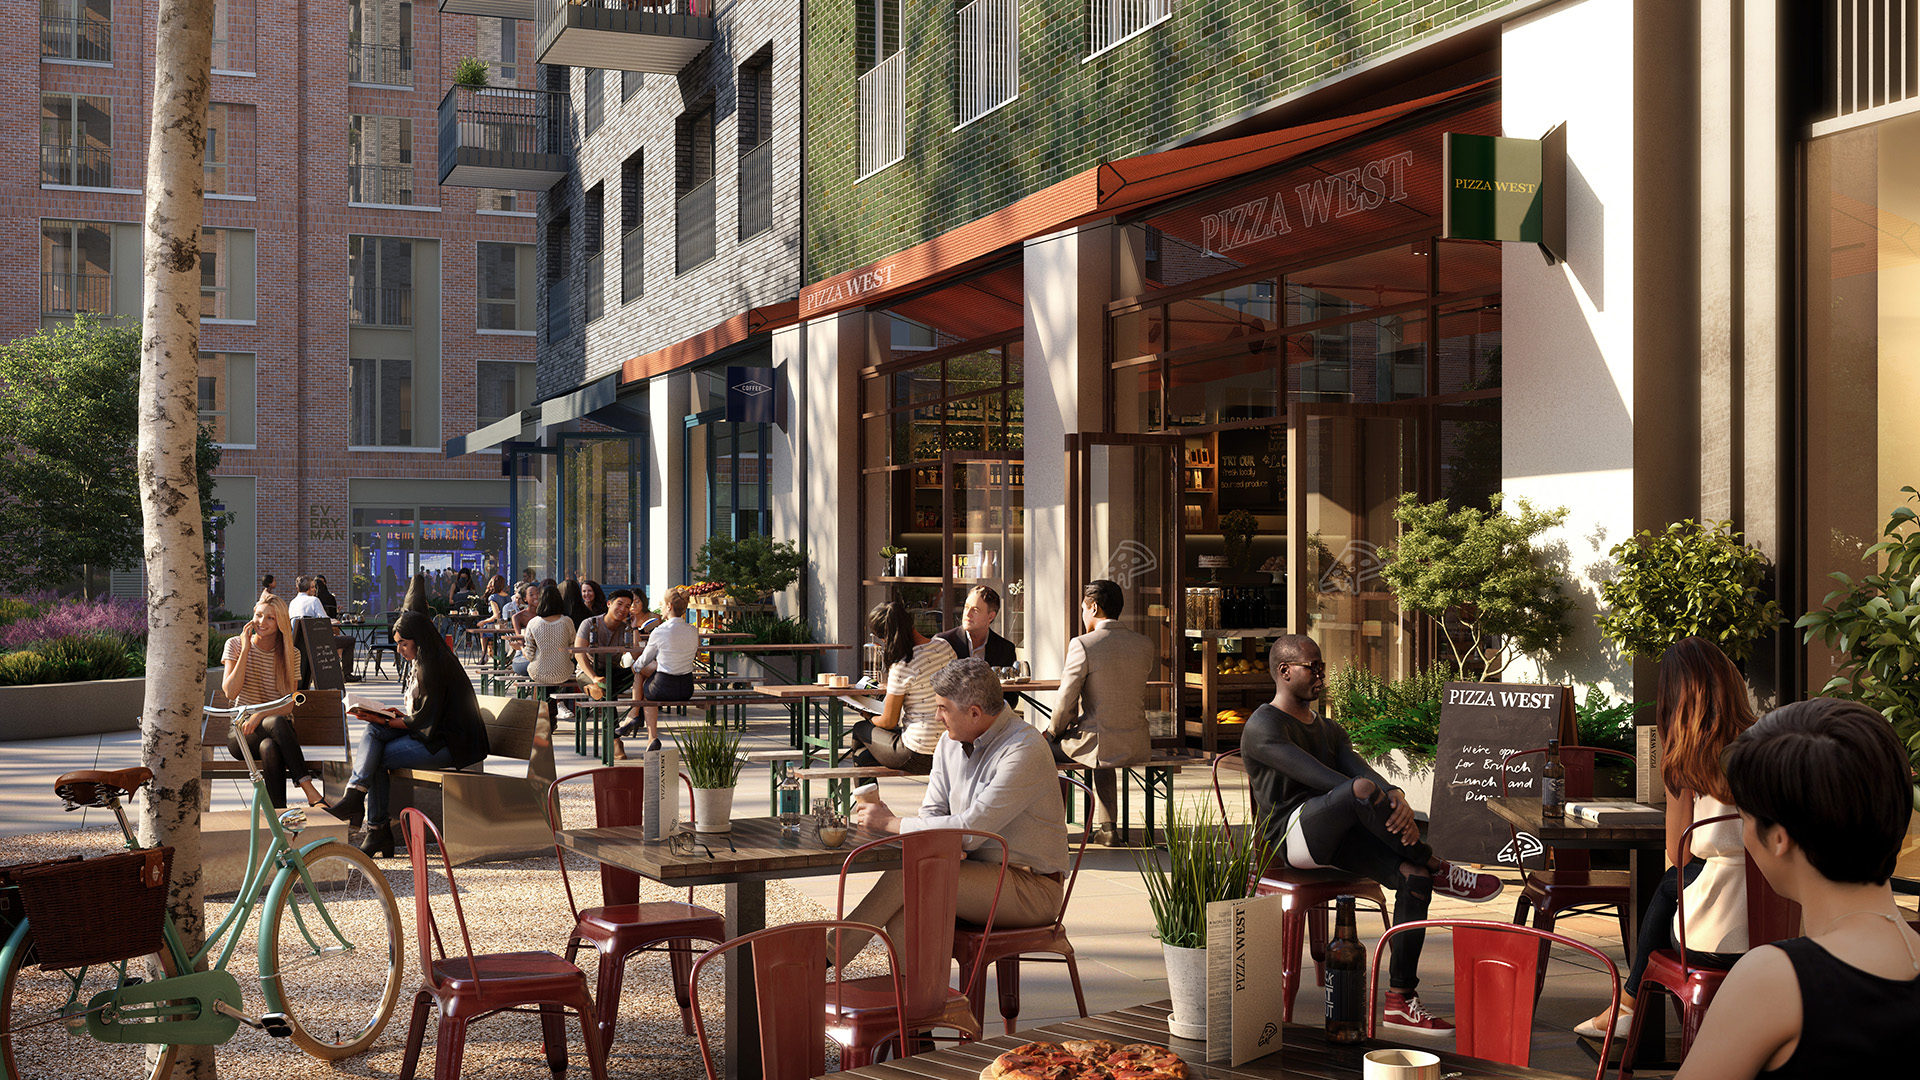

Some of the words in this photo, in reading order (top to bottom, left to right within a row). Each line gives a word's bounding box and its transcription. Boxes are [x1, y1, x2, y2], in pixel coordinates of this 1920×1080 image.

[1455, 178, 1492, 191] PIZZA
[1494, 181, 1535, 194] WEST
[1201, 192, 1292, 258] PIZZA
[1295, 150, 1413, 228] WEST
[807, 283, 843, 311] PIZZA
[846, 264, 896, 297] WEST
[310, 530, 344, 541] MAN
[423, 528, 478, 541] ENTRANCE
[1448, 689, 1496, 707] PIZZA
[1499, 691, 1555, 710] WEST
[1482, 758, 1532, 773] Brunch
[1452, 773, 1498, 788] Lunch
[1507, 777, 1534, 789] and
[1465, 789, 1501, 802] Din
[1235, 908, 1246, 952] WEST
[1235, 952, 1246, 992] PIZZA
